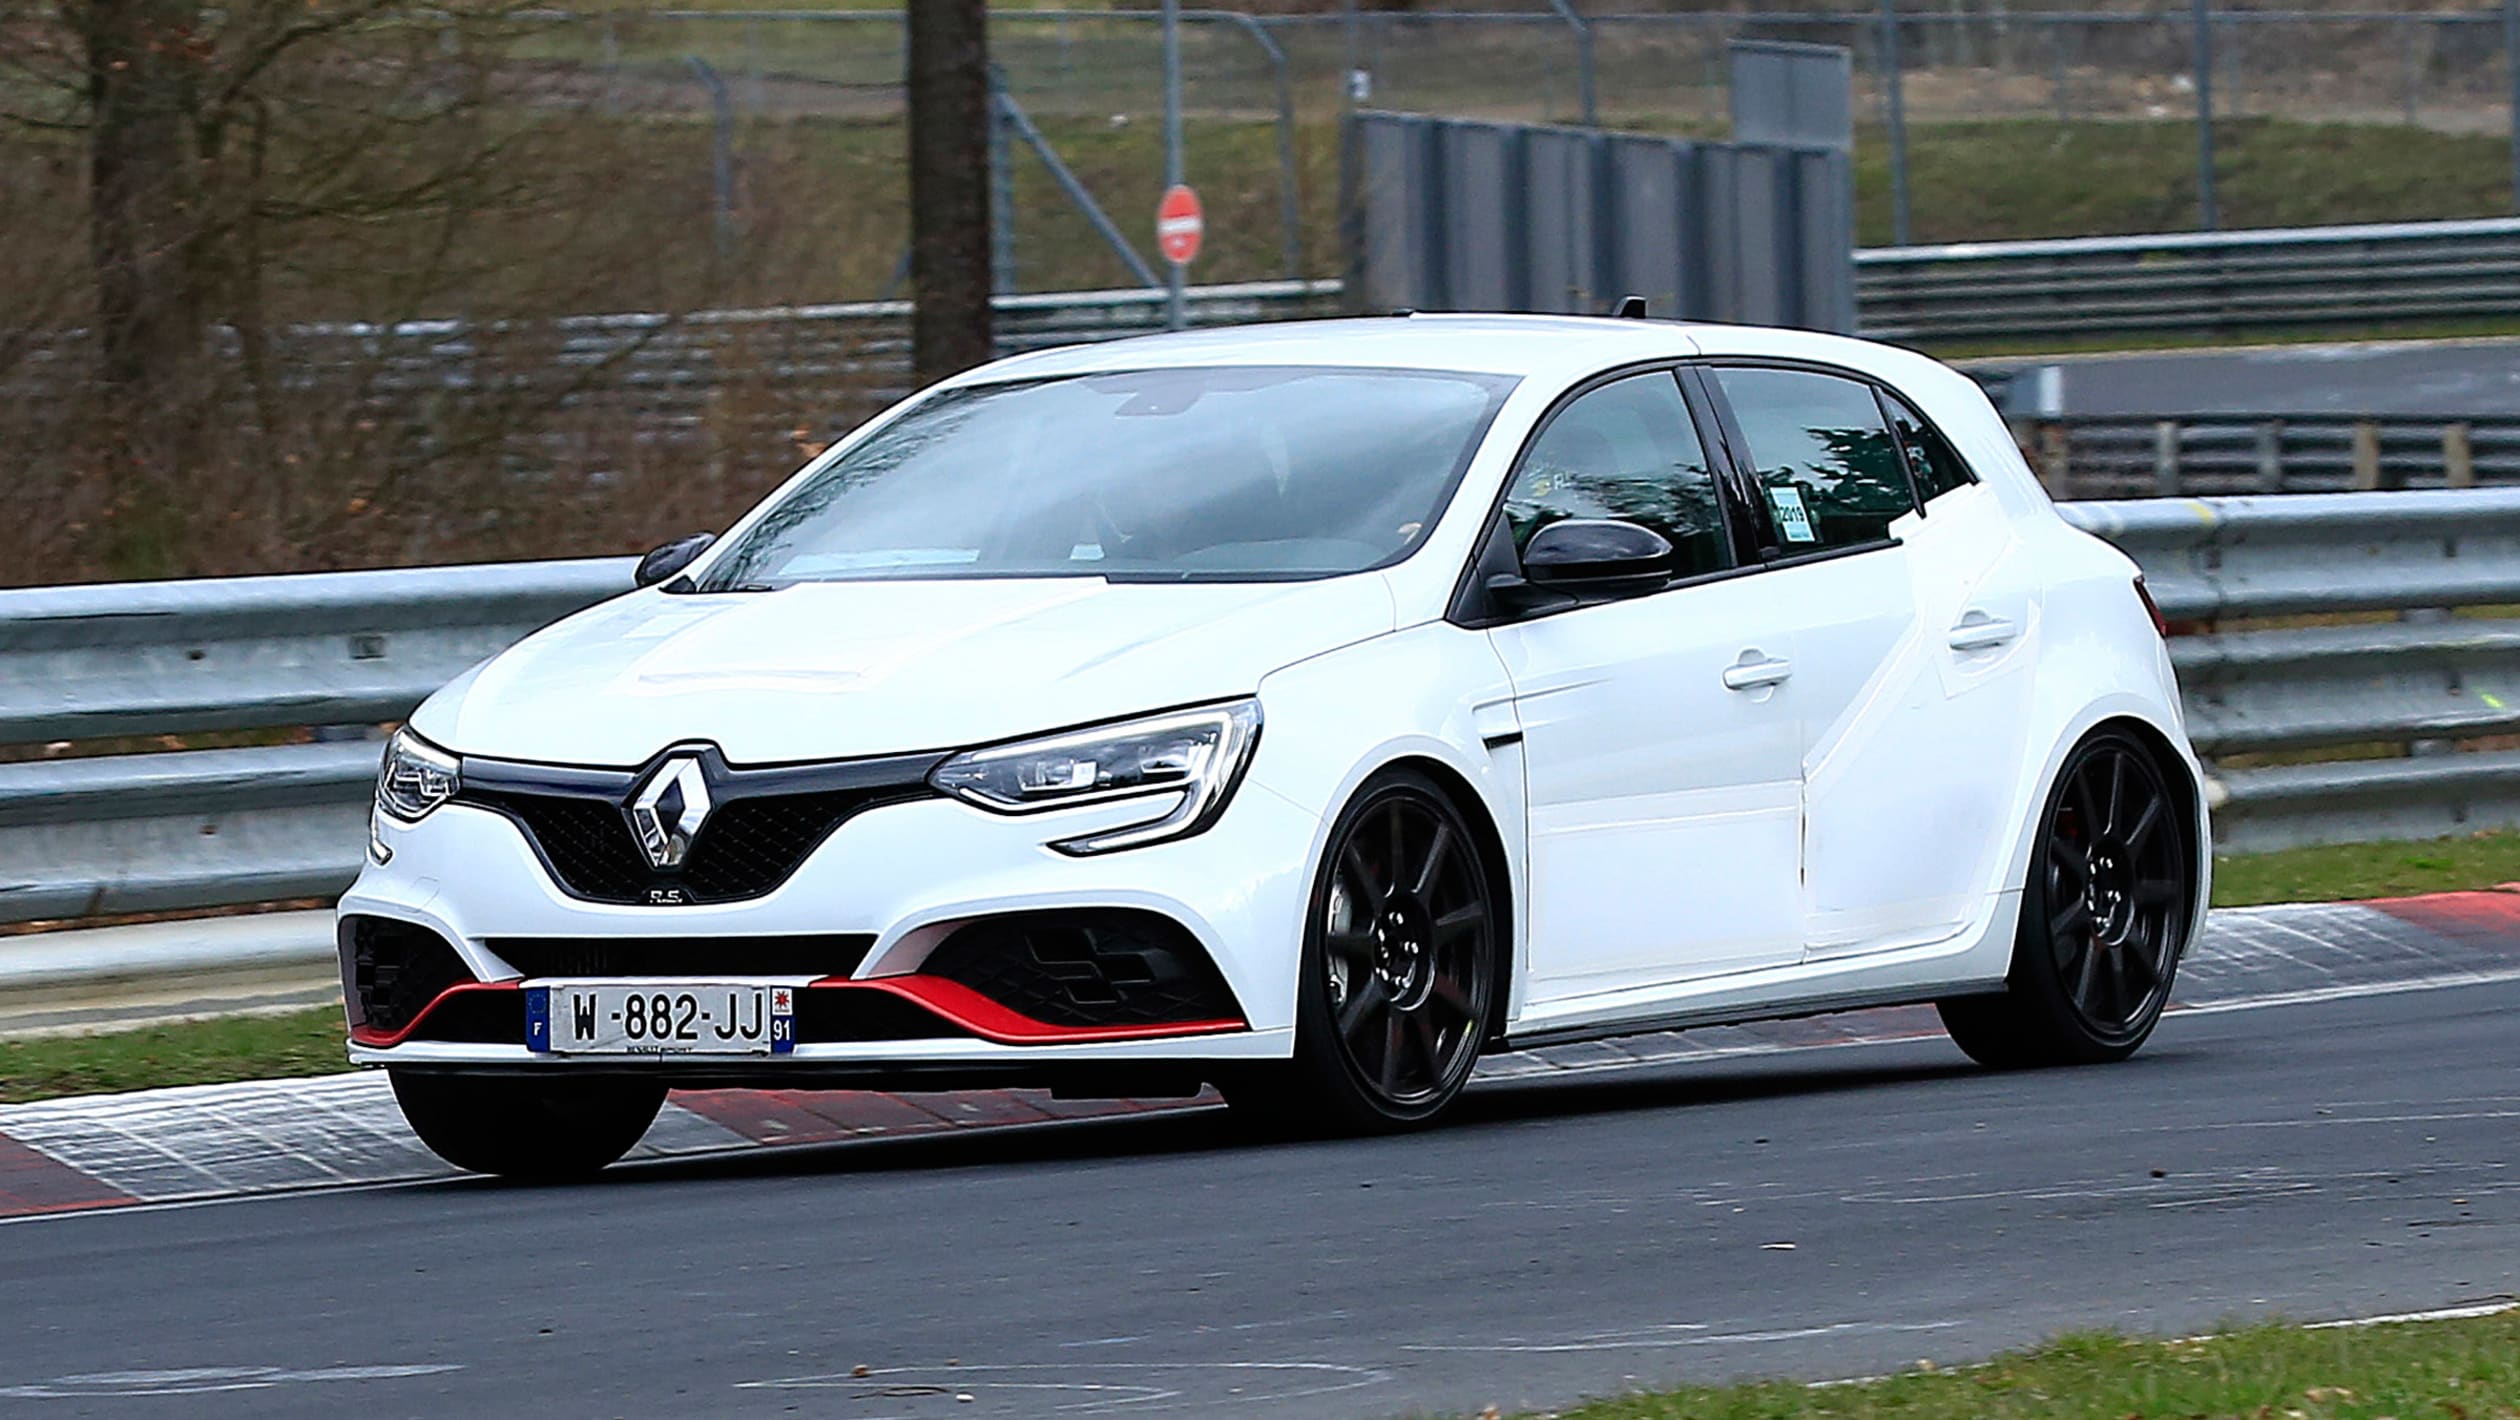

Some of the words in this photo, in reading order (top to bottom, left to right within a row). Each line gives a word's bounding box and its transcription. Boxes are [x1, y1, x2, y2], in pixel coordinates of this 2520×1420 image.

[1779, 505, 1805, 523] 2019
[534, 1022, 543, 1036] F
[773, 1019, 791, 1041] 91
